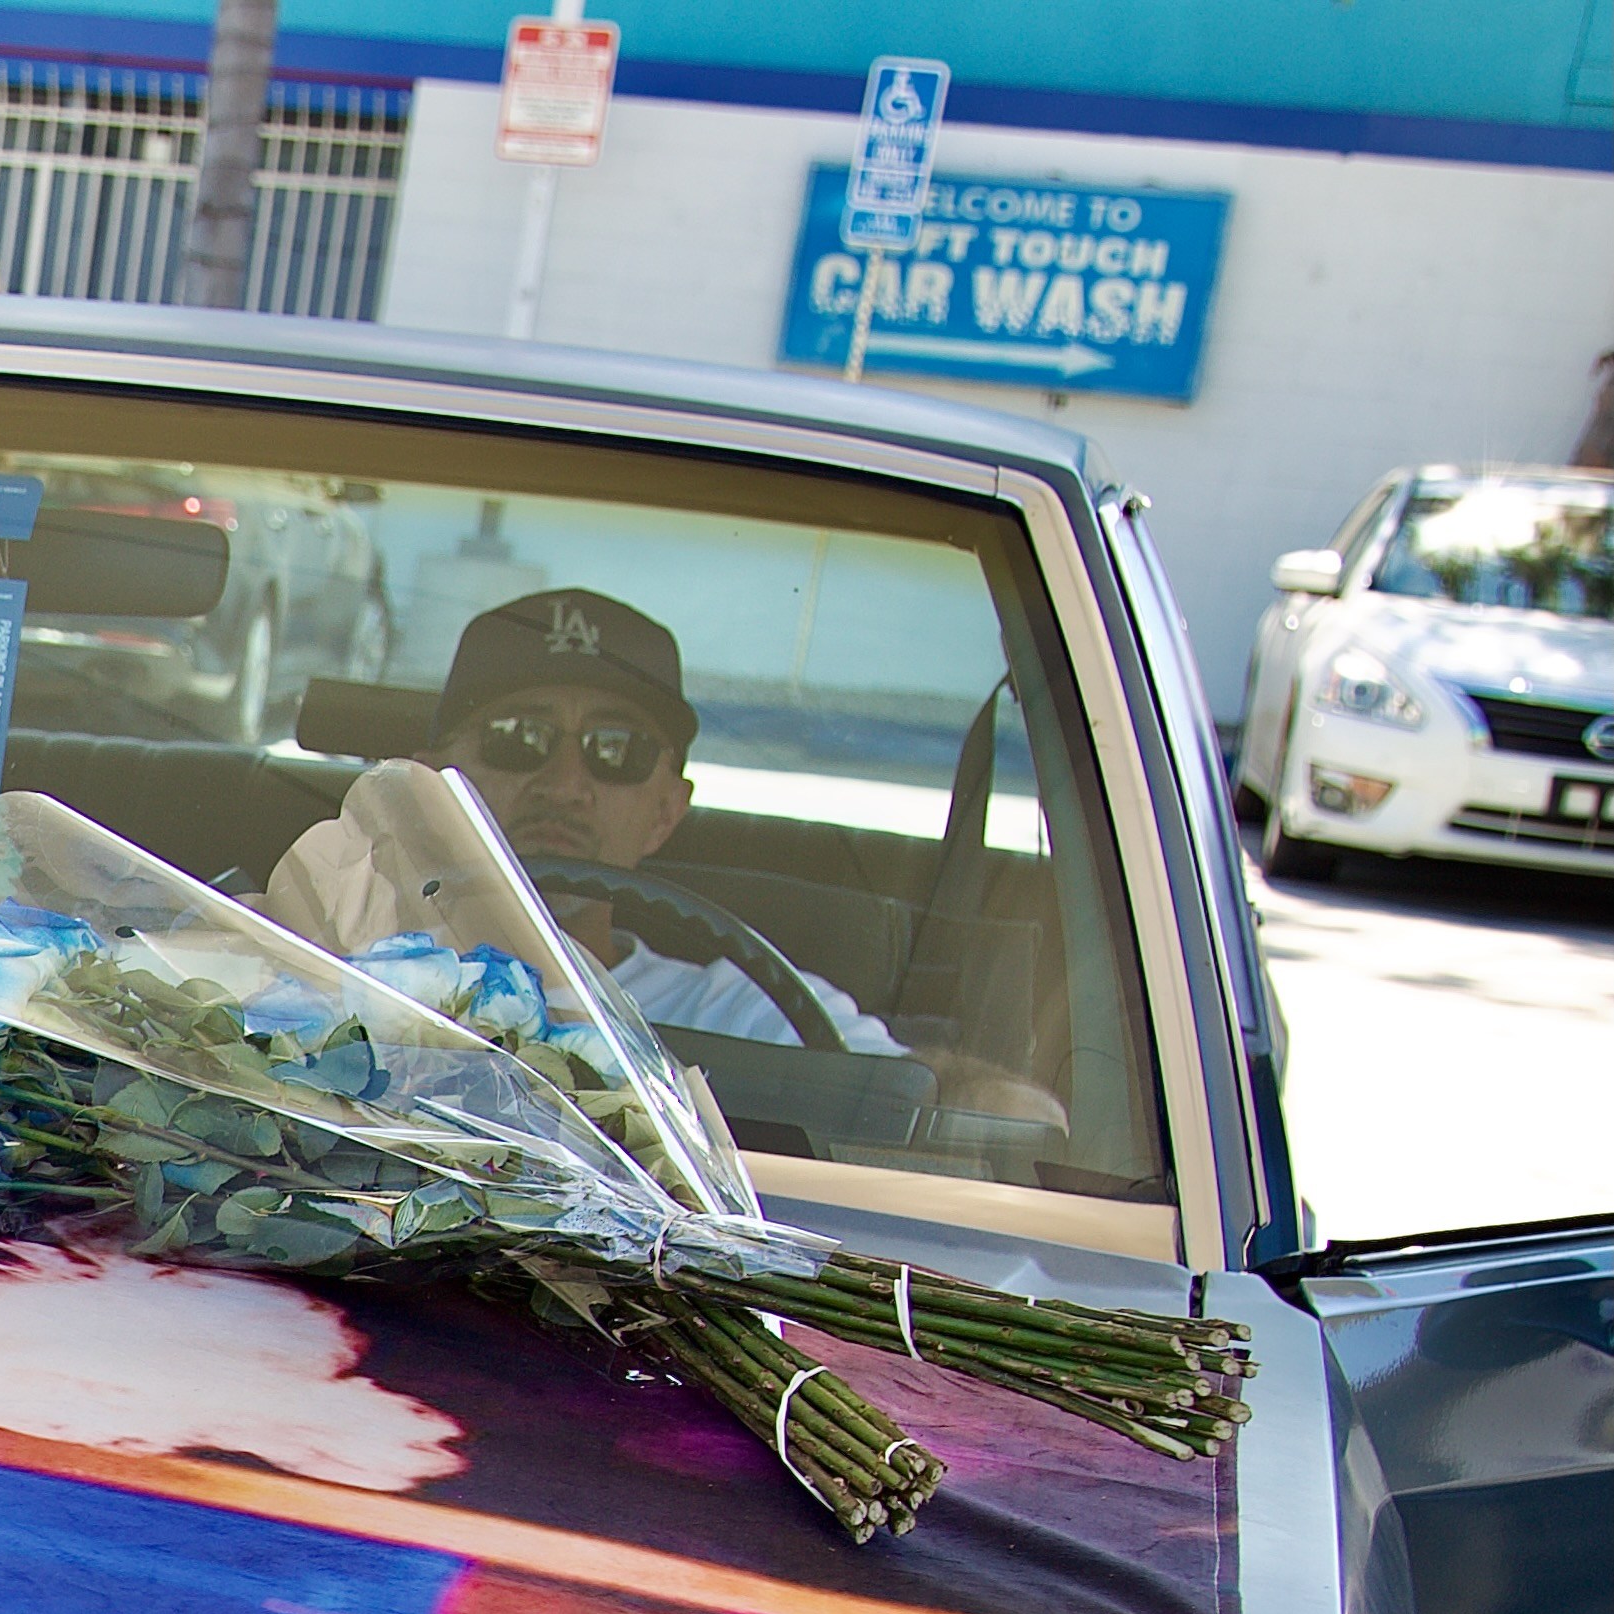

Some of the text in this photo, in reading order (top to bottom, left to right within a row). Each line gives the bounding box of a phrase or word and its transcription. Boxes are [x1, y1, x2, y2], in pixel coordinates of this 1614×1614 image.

[922, 184, 1075, 227] ELCOME
[1089, 196, 1142, 232] TO
[915, 222, 977, 262] FT
[991, 227, 1170, 278] TOUCH
[810, 253, 1187, 346] CAR WASH
[545, 600, 600, 656] LA
